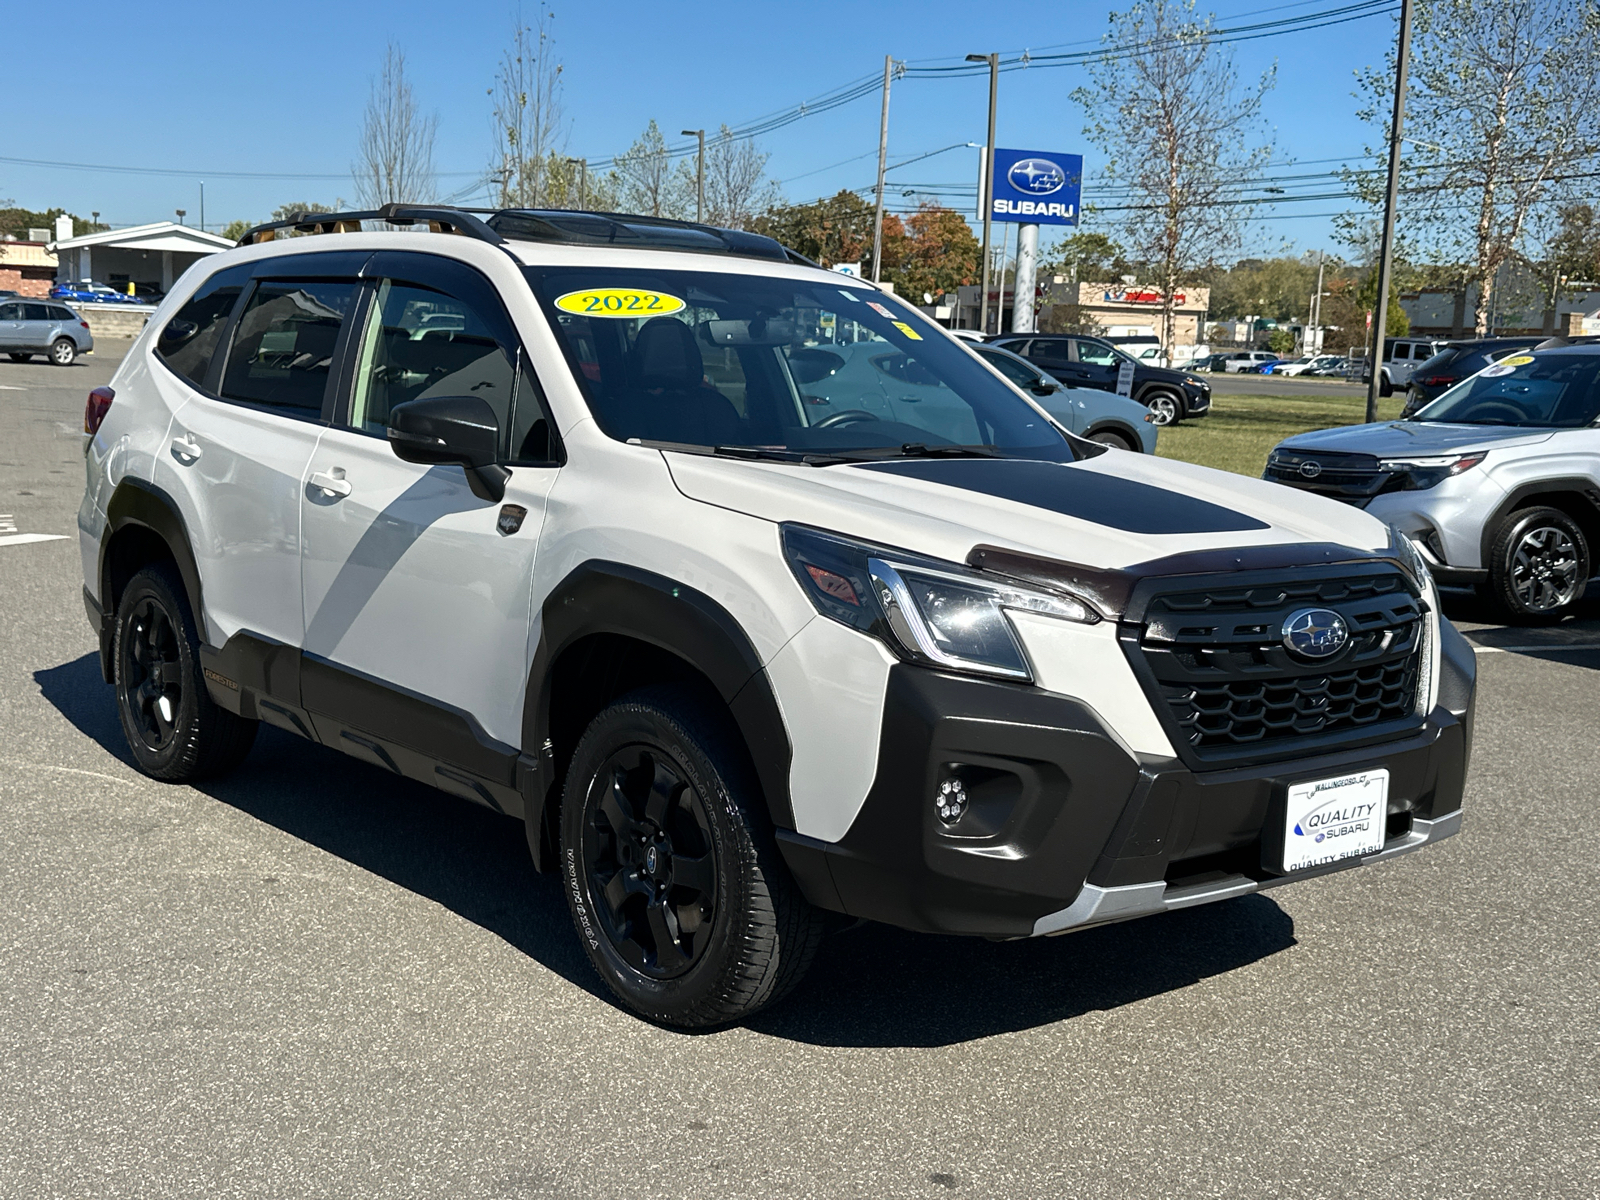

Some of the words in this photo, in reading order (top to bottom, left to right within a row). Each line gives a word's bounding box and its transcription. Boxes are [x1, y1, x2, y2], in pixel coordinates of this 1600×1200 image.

[993, 198, 1074, 218] SUBARU
[581, 294, 664, 312] 2022
[1308, 803, 1376, 828] QUALITY
[1326, 822, 1370, 839] SUBARU
[1289, 854, 1336, 871] QUALITY
[1339, 843, 1381, 860] SUBARU
[566, 848, 599, 950] YOKOHAMA
